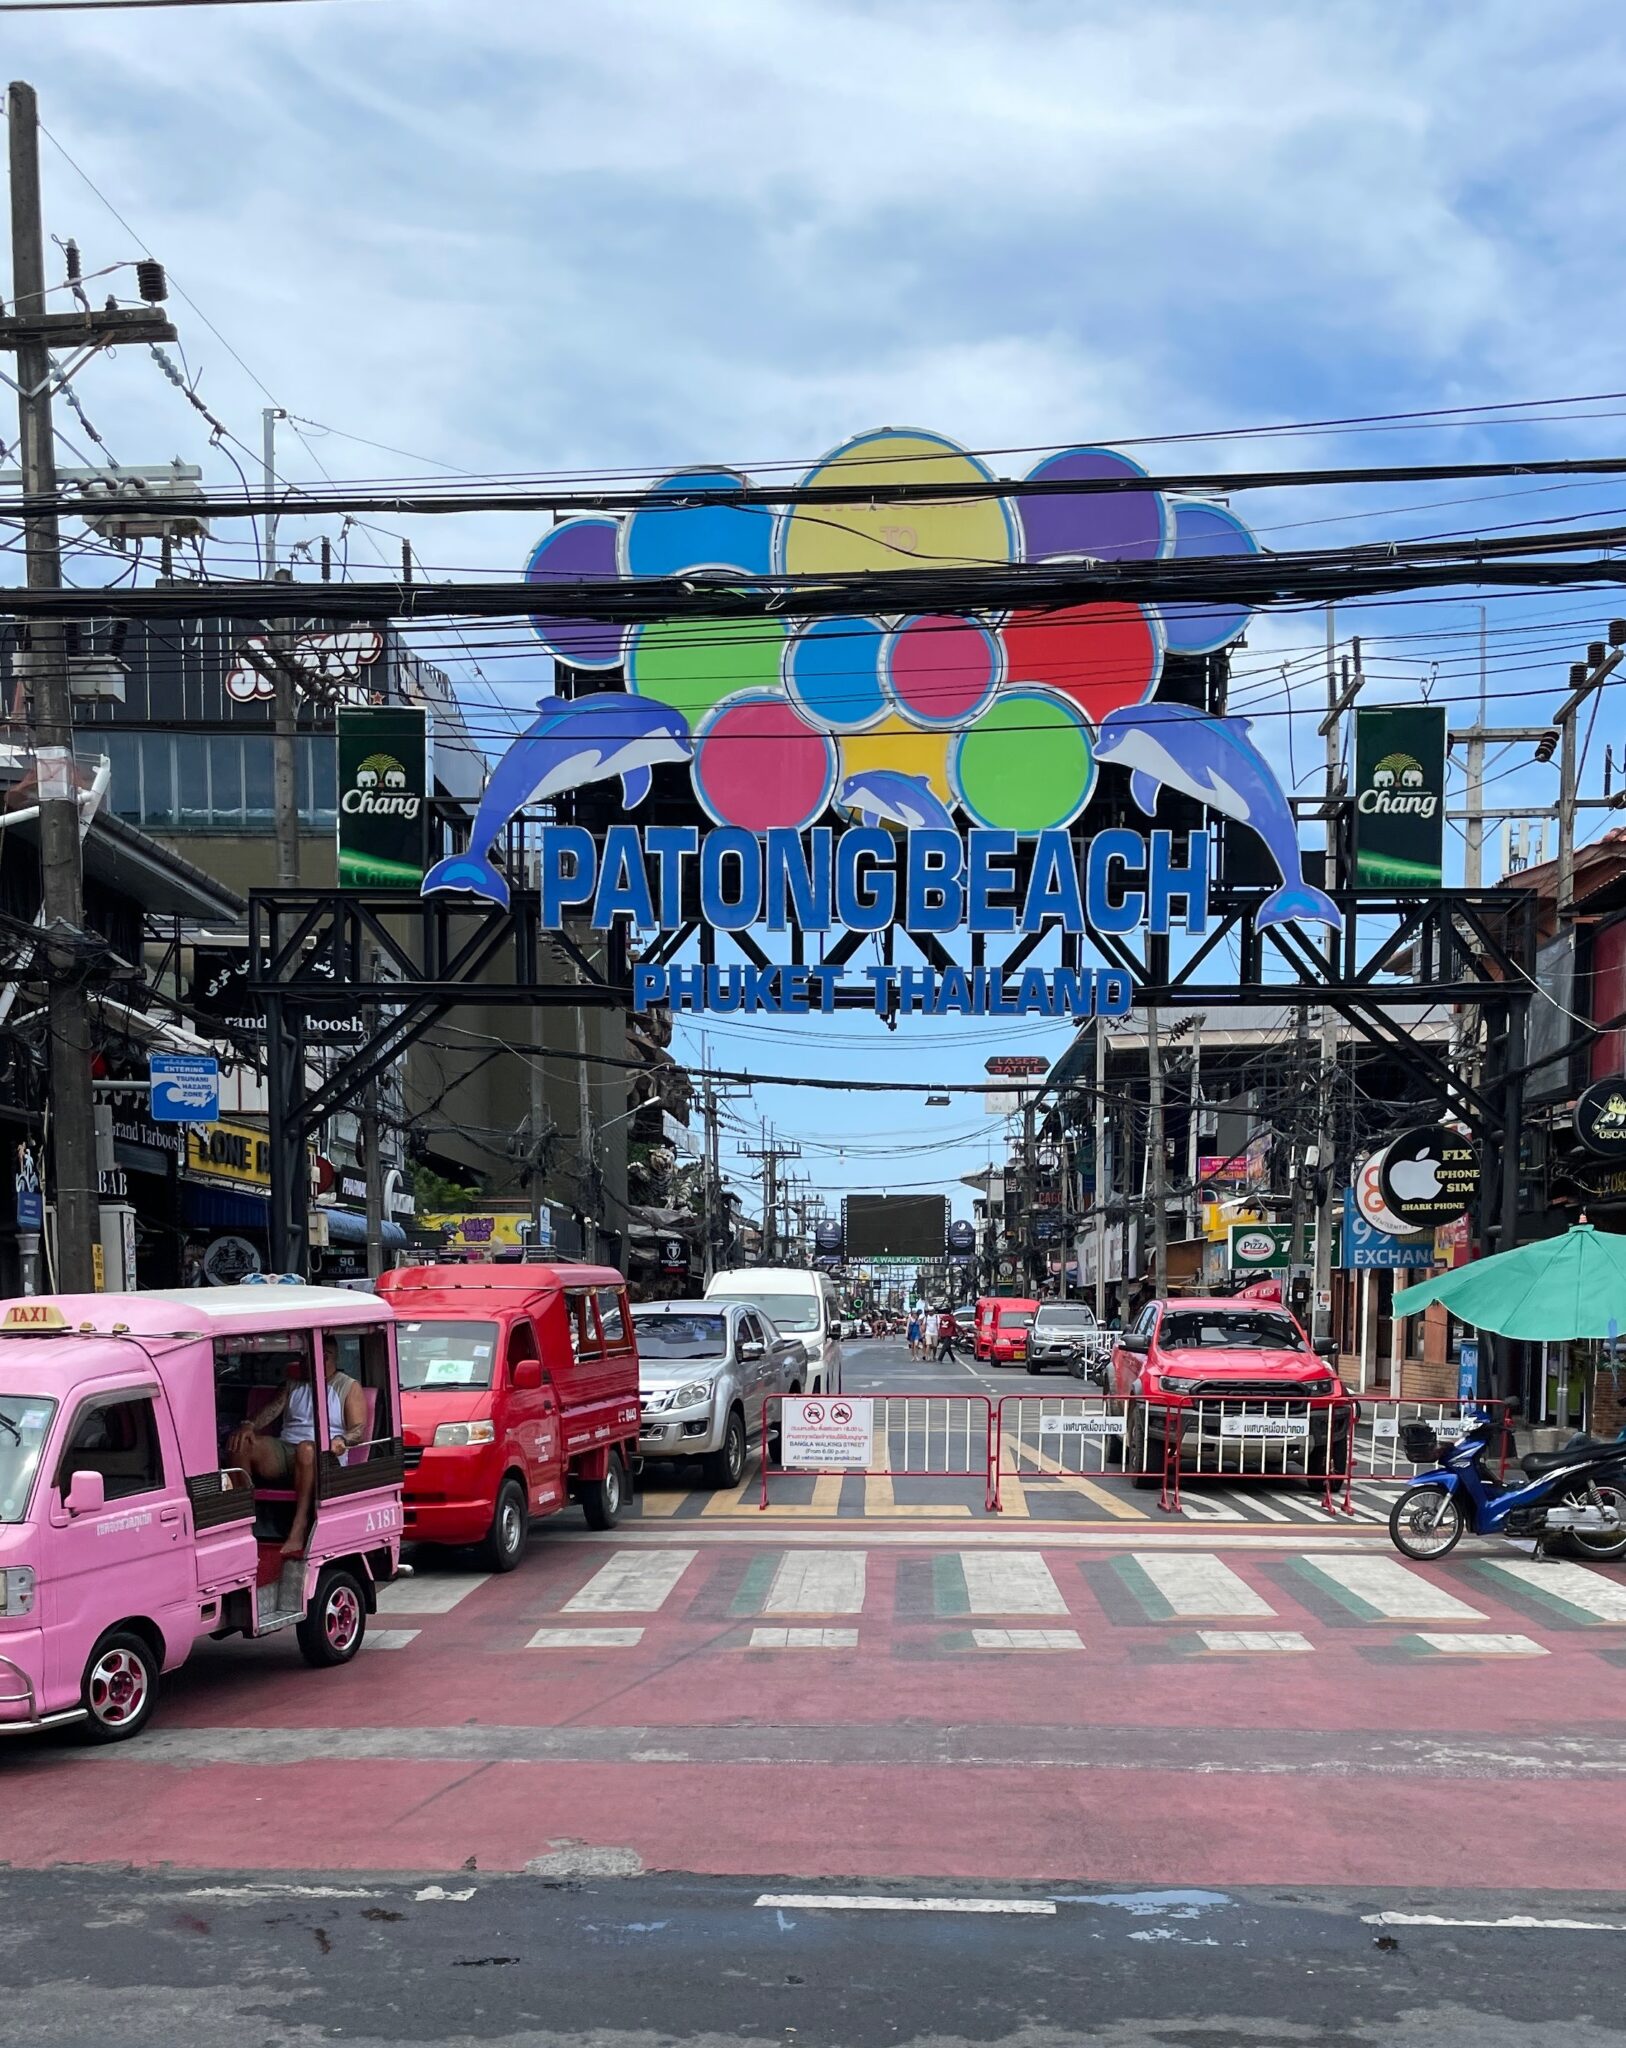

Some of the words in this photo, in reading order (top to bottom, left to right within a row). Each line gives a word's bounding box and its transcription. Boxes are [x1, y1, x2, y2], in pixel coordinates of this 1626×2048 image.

[879, 525, 918, 553] TO
[341, 789, 421, 820] Chang
[1358, 788, 1438, 819] Chang
[541, 825, 897, 932] PATONG
[906, 828, 1210, 935] BEACH
[633, 963, 844, 1014] PHUKET
[866, 965, 1133, 1017] THAILAND
[224, 1014, 267, 1030] rand
[997, 1057, 1040, 1065] LASER
[164, 1065, 205, 1073] ENTERING
[994, 1065, 1041, 1074] BATTLE
[1599, 1130, 1626, 1139] OSCA
[1442, 1149, 1473, 1161] FIX
[1436, 1169, 1481, 1179] IPHONE
[1446, 1183, 1475, 1193] SIM
[1401, 1203, 1433, 1211] SHARK
[1433, 1202, 1465, 1210] PHONE
[1243, 1241, 1269, 1250] PIZZA
[848, 1256, 879, 1264] BANGLA
[880, 1256, 915, 1264] WALKING
[916, 1256, 943, 1264] STREET
[10, 1307, 48, 1323] TAXI
